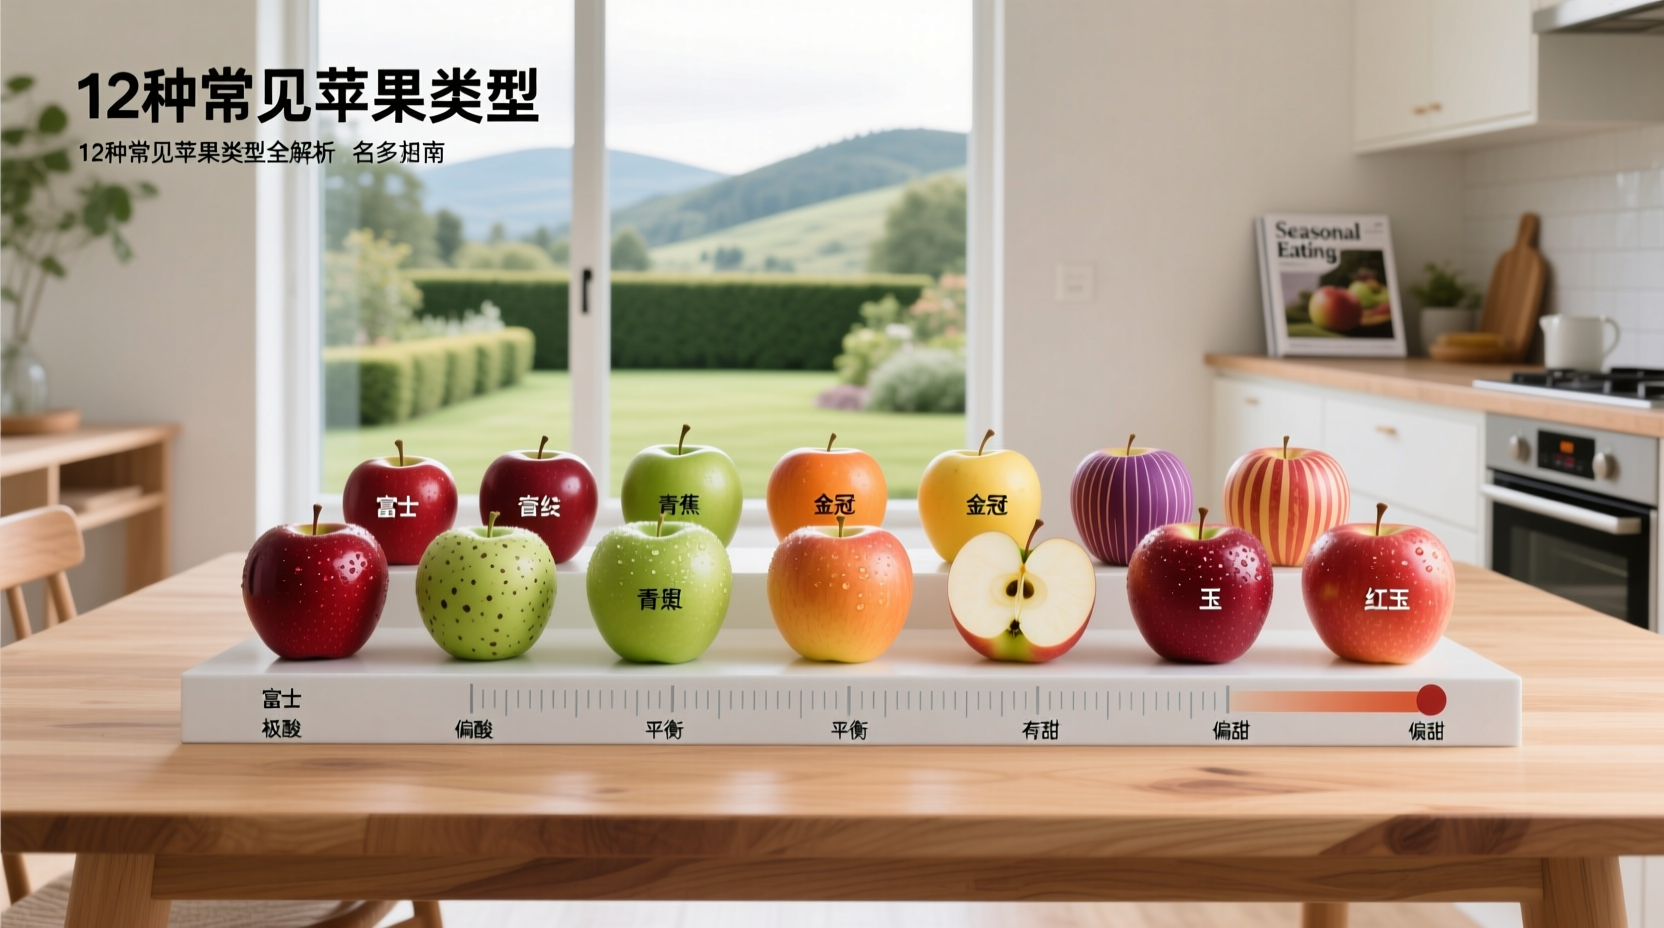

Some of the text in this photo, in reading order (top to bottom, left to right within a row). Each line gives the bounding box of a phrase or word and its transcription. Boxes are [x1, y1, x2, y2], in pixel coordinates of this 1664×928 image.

[1276, 221, 1361, 241] Seasonal
[1277, 241, 1338, 264] Eating
[376, 494, 420, 519] 富士
[813, 493, 856, 516] 金冠
[966, 493, 1008, 516] 金冠
[1199, 588, 1222, 610] 玉
[1364, 587, 1411, 611] 红玉
[262, 687, 302, 709] 富士
[261, 718, 302, 739] 极酸
[454, 719, 494, 740] 偏酸
[645, 719, 685, 741] 平衡
[831, 719, 869, 741] 平衡
[1212, 719, 1251, 741] 偏甜
